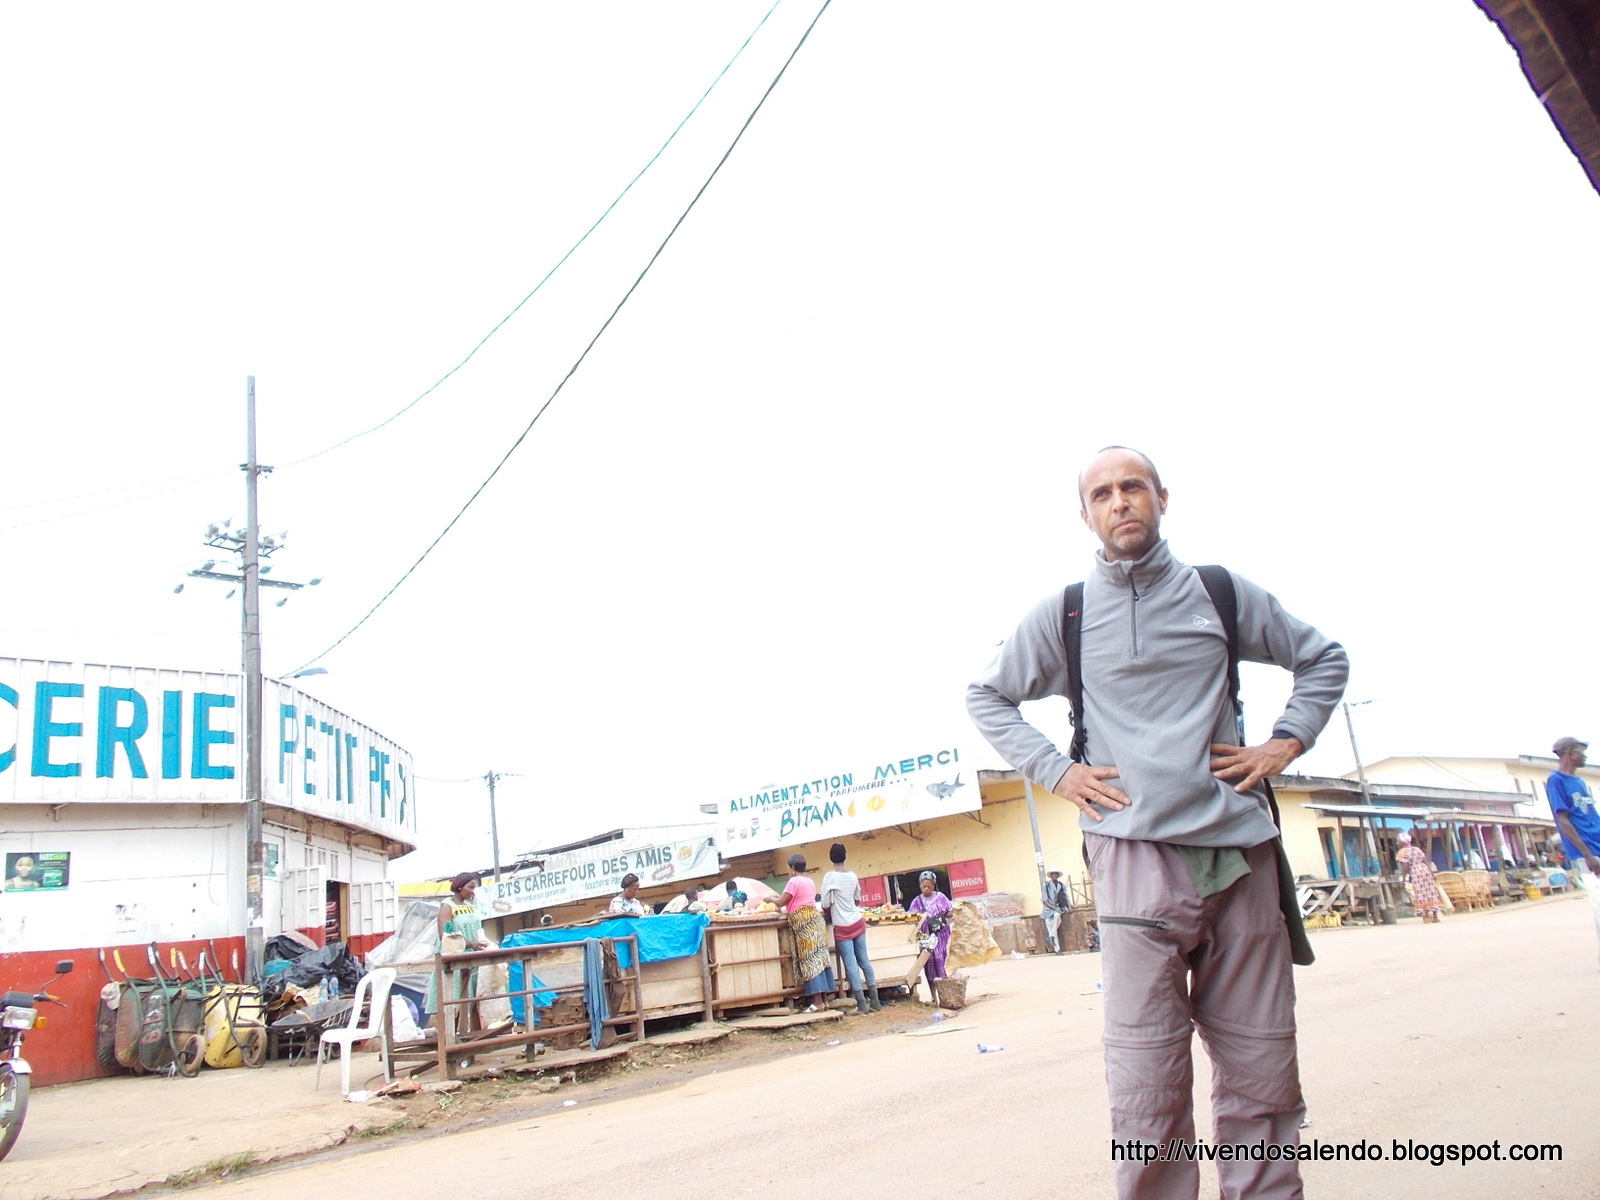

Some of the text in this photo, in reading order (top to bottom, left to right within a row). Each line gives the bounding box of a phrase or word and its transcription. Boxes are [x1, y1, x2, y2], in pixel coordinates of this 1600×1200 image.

[278, 702, 358, 805] PETIT
[729, 748, 959, 814] ALIMENTATION MERCI
[779, 801, 843, 839] BITAM
[497, 877, 521, 899] ETS
[524, 861, 597, 892] CARREFOUR
[602, 855, 629, 878] DES
[635, 846, 673, 870] AMIS
[871, 892, 882, 901] LES
